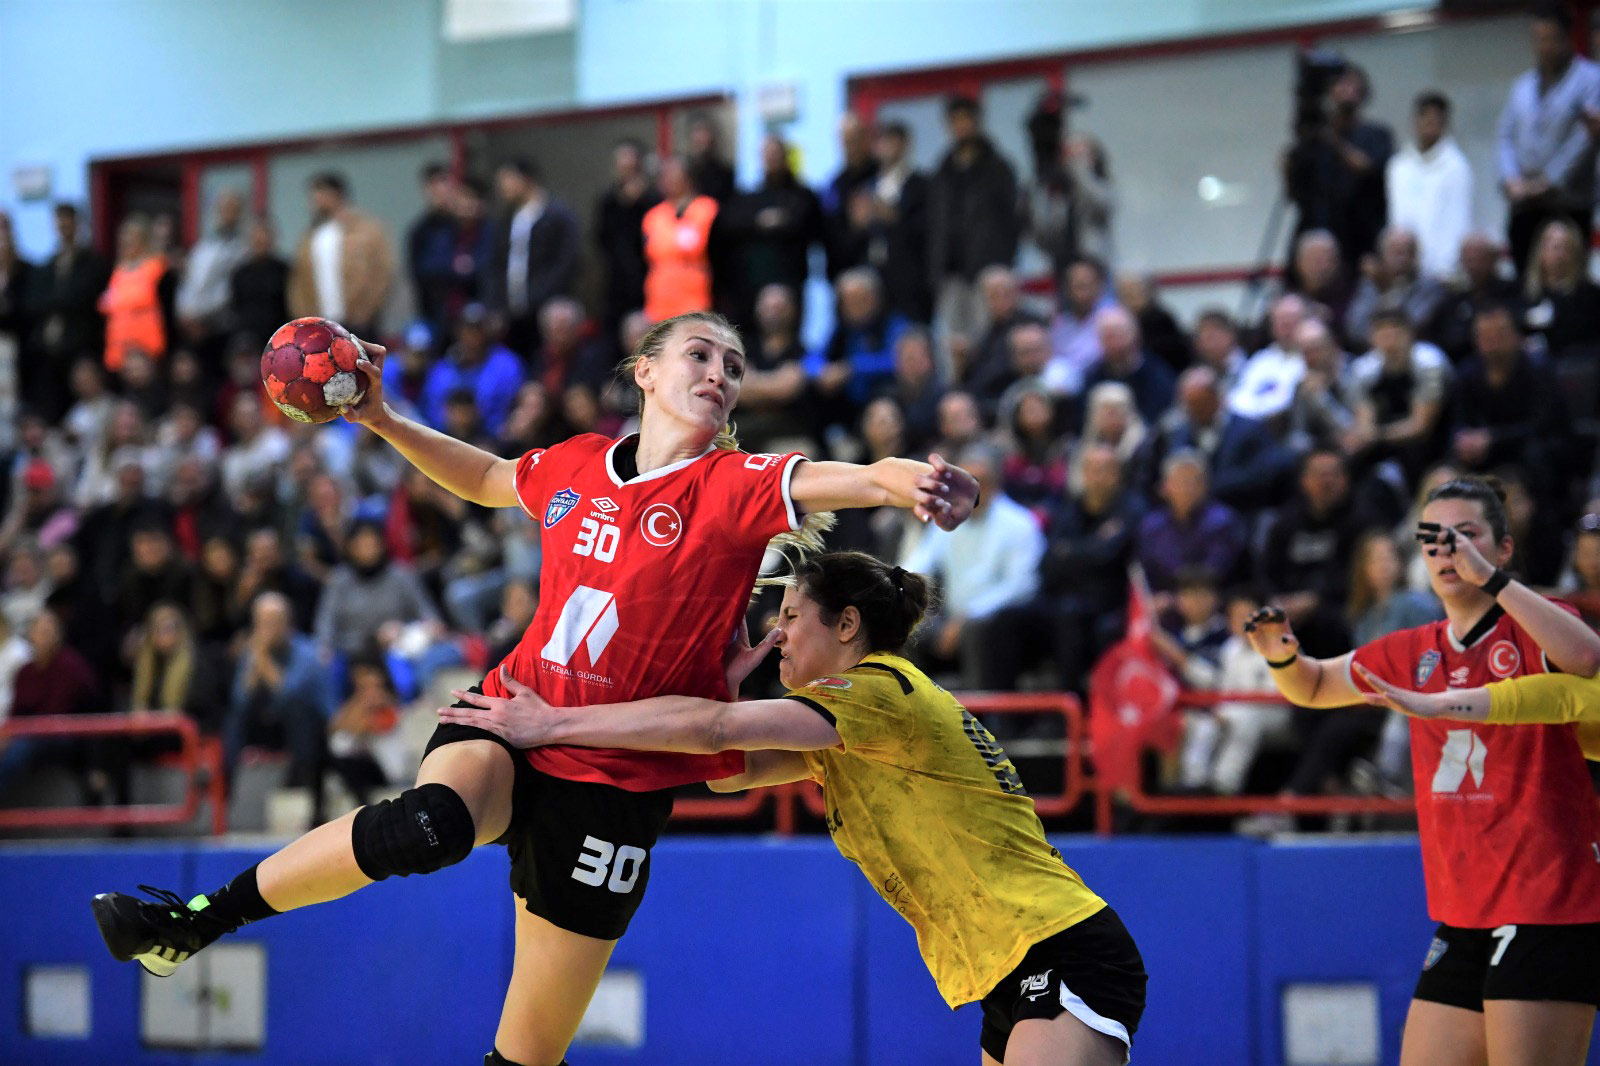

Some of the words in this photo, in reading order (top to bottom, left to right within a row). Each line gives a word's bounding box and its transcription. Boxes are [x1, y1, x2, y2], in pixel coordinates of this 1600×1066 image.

[590, 510, 615, 522] umbro
[572, 517, 620, 563] 30
[577, 670, 614, 685] GÜRDAL
[416, 810, 439, 846] SELECT
[571, 834, 647, 894] 30
